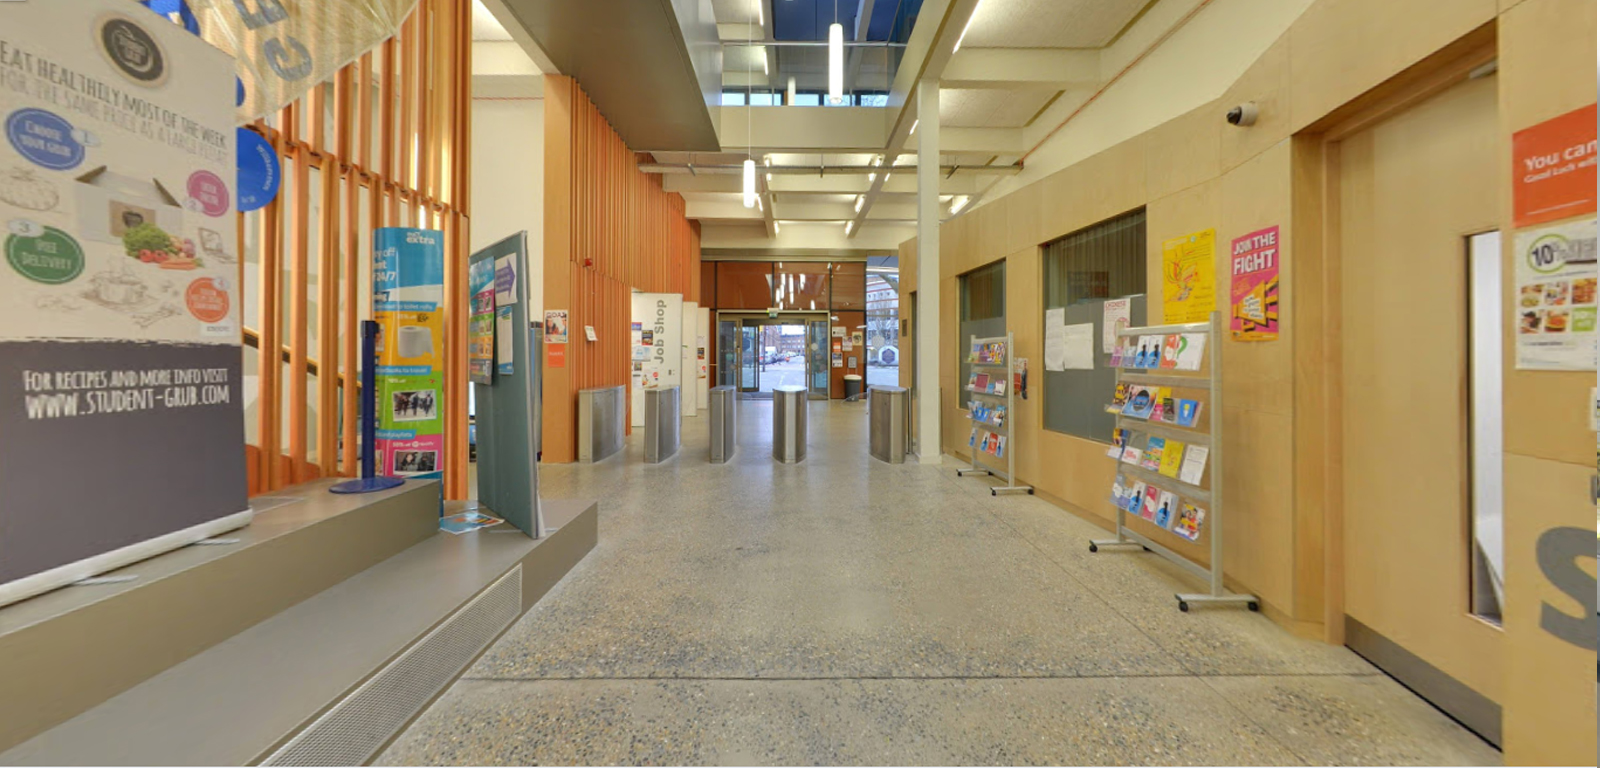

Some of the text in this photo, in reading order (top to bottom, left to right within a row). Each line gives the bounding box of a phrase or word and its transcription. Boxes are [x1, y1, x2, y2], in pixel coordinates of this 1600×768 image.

[0, 40, 229, 151] EAT HEALTHILY MOST OF THE WEEK
[1523, 151, 1560, 171] You
[1523, 169, 1551, 183] Good
[406, 236, 435, 245] extra
[1233, 231, 1276, 255] JOIN THE
[1233, 248, 1276, 275] FIGHT
[654, 299, 667, 364] Job Shop
[23, 368, 228, 391] FOR RECIPES AND MORE INFO VISIT
[24, 385, 230, 420] WWW.STUDENT-GRUB.COM
